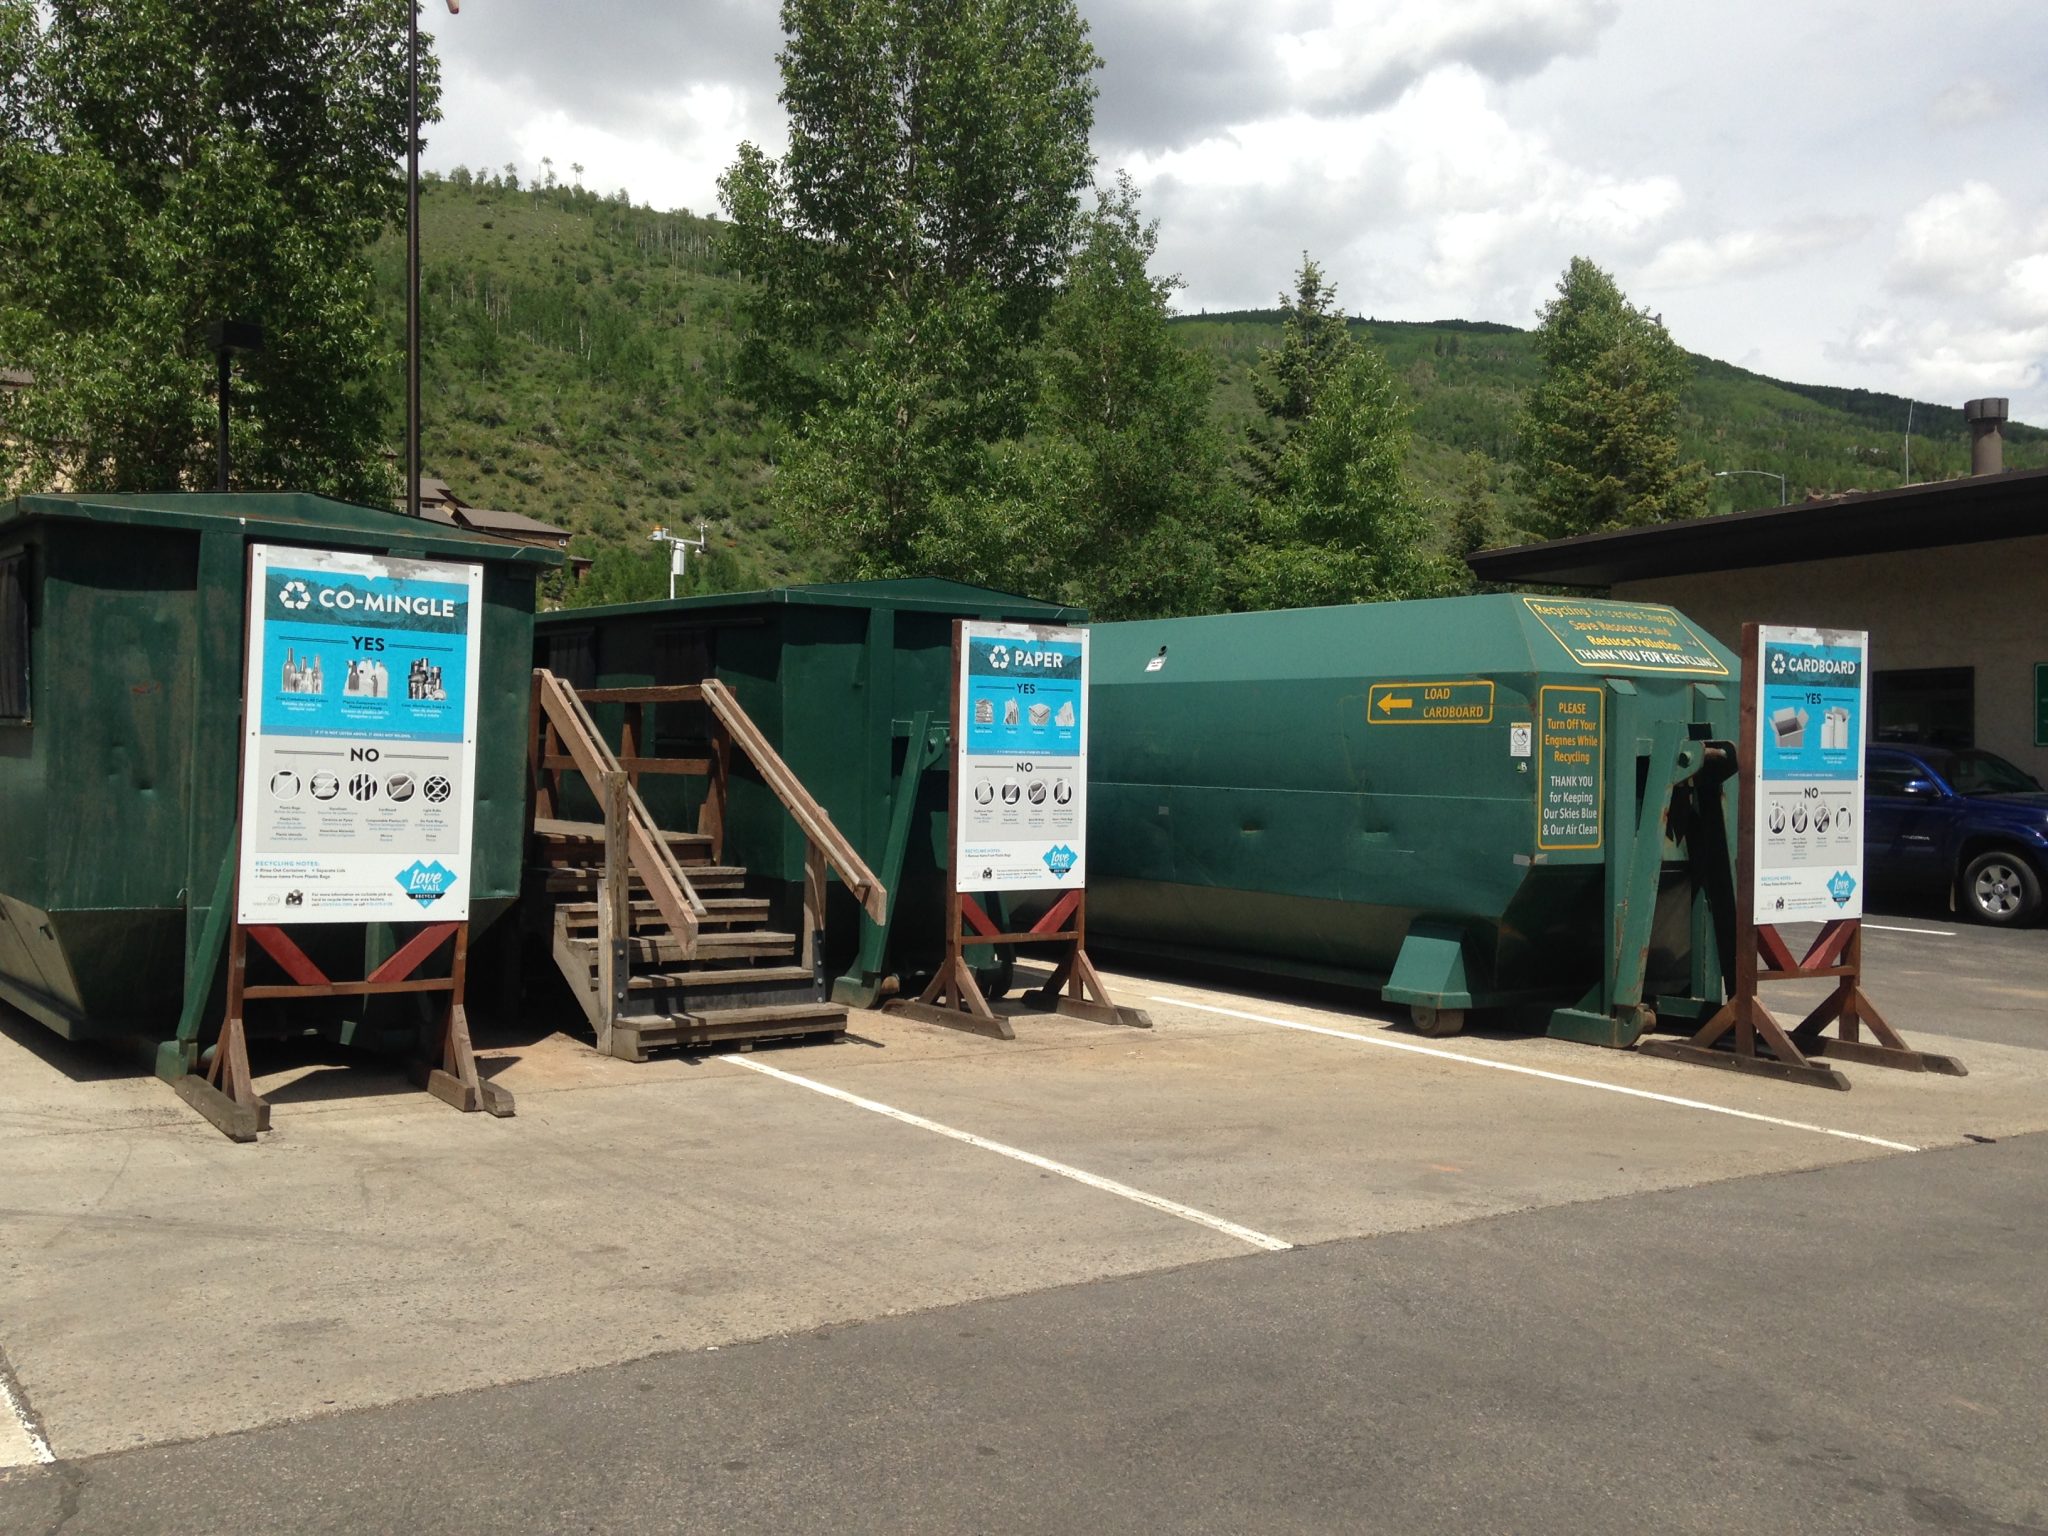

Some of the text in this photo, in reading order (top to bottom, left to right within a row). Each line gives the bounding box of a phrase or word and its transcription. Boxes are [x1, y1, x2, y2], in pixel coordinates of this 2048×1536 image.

[319, 588, 455, 618] CO-MINGLE
[1534, 604, 1591, 618] Recycling
[1569, 620, 1599, 631] Save
[1596, 620, 1653, 634] Resources
[351, 636, 385, 651] YES
[1586, 635, 1682, 651] Reduces Pollution
[1015, 651, 1063, 668] PAPER
[1575, 648, 1718, 668] THANK YOU FOR RECYCLING
[1788, 658, 1856, 675] CARDBOARD
[1016, 683, 1036, 694] YES
[1424, 688, 1450, 700] LOAD
[1805, 693, 1821, 704] YES
[1423, 706, 1484, 718] CARDBOARD
[1558, 703, 1587, 714] PLEASE
[1547, 718, 1596, 731] Turn Off Your
[1545, 735, 1598, 748] Engines While
[350, 748, 379, 762] NO
[1554, 752, 1590, 765] Recycling
[1016, 762, 1033, 773] NO
[1551, 776, 1593, 787] THANK YOU
[1550, 792, 1593, 805] for Keeping
[1804, 787, 1819, 799] NO
[1544, 807, 1598, 819] Our Skies Blue
[1542, 823, 1598, 836] & Our Air Clean
[410, 869, 443, 890] Love
